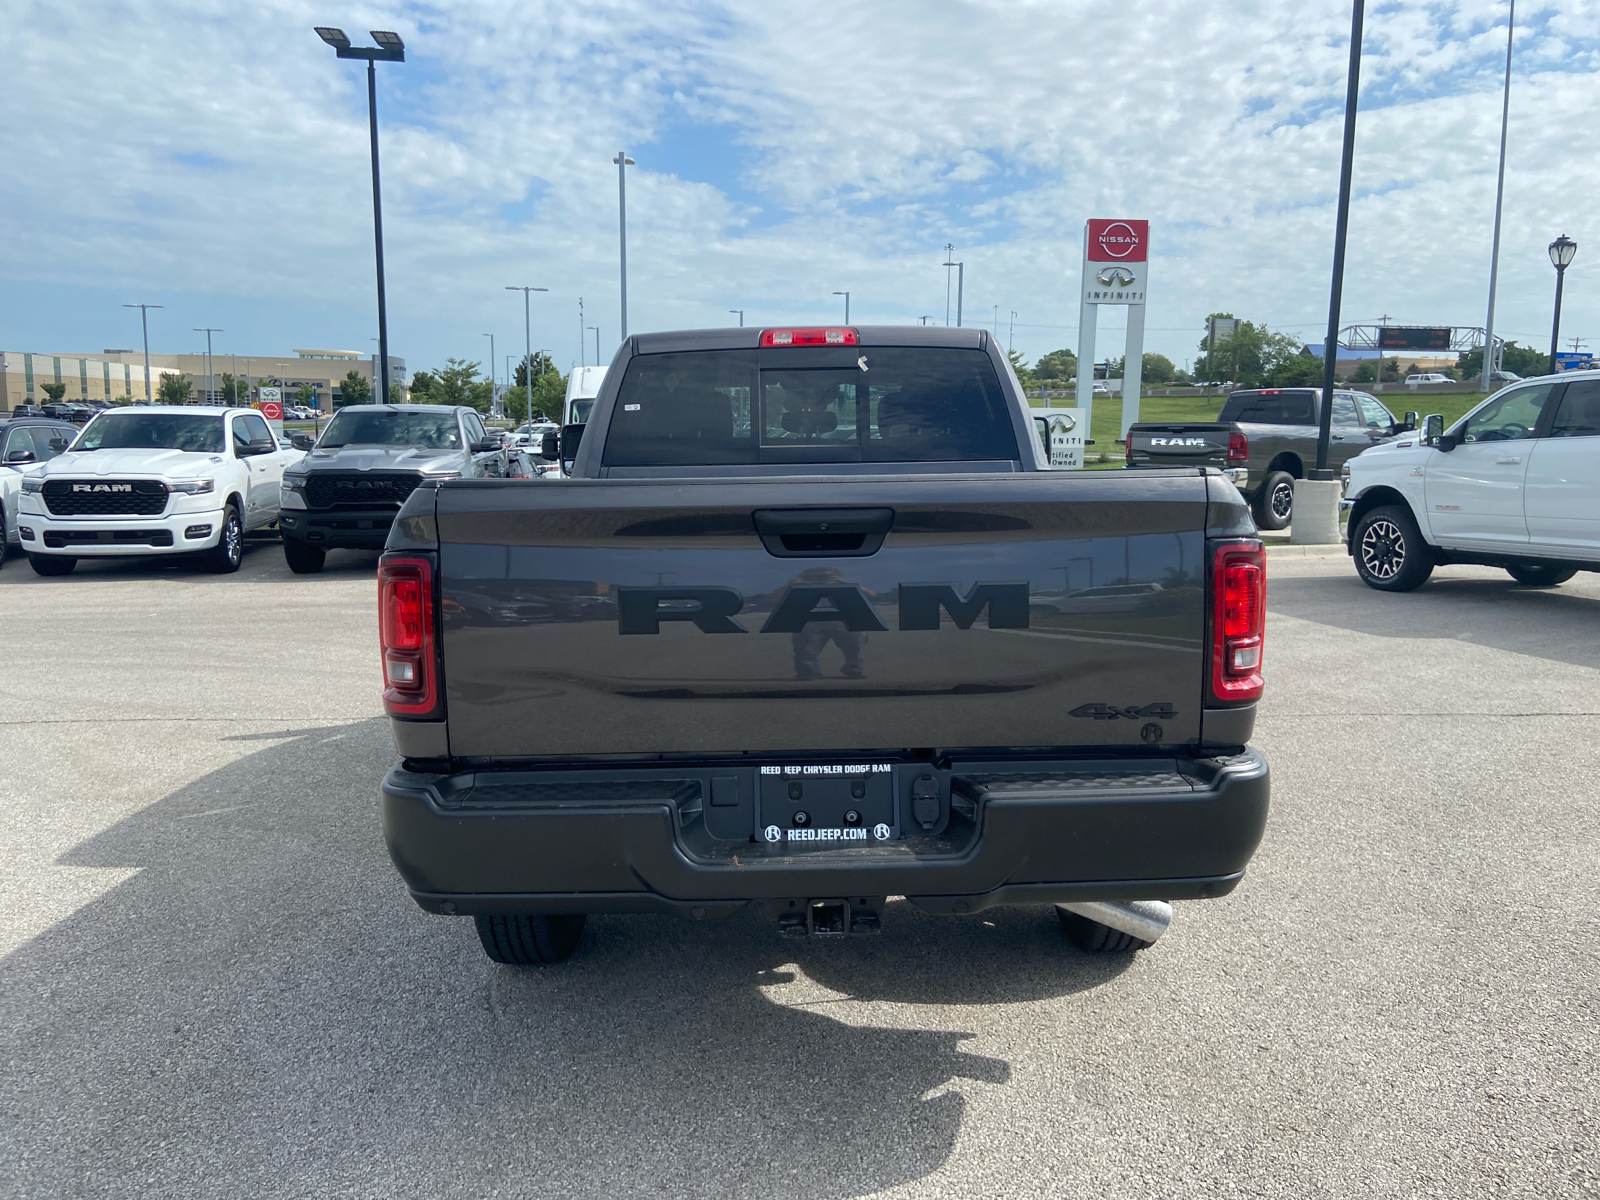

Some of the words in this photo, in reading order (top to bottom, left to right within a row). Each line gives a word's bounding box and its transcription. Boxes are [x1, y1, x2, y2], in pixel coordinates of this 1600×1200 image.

[1087, 291, 1143, 300] INFINITI
[1150, 437, 1206, 447] RAM
[72, 484, 132, 492] RAM
[336, 481, 393, 489] RAM
[618, 580, 1030, 635] RAM
[1067, 702, 1179, 720] 4x4
[760, 765, 781, 775] REED
[783, 765, 801, 774] JEEP
[803, 765, 843, 774] CHRYSLER
[844, 764, 871, 773] DODGE
[872, 763, 891, 773] RAM
[787, 828, 867, 841] REEDJEEP.COM
